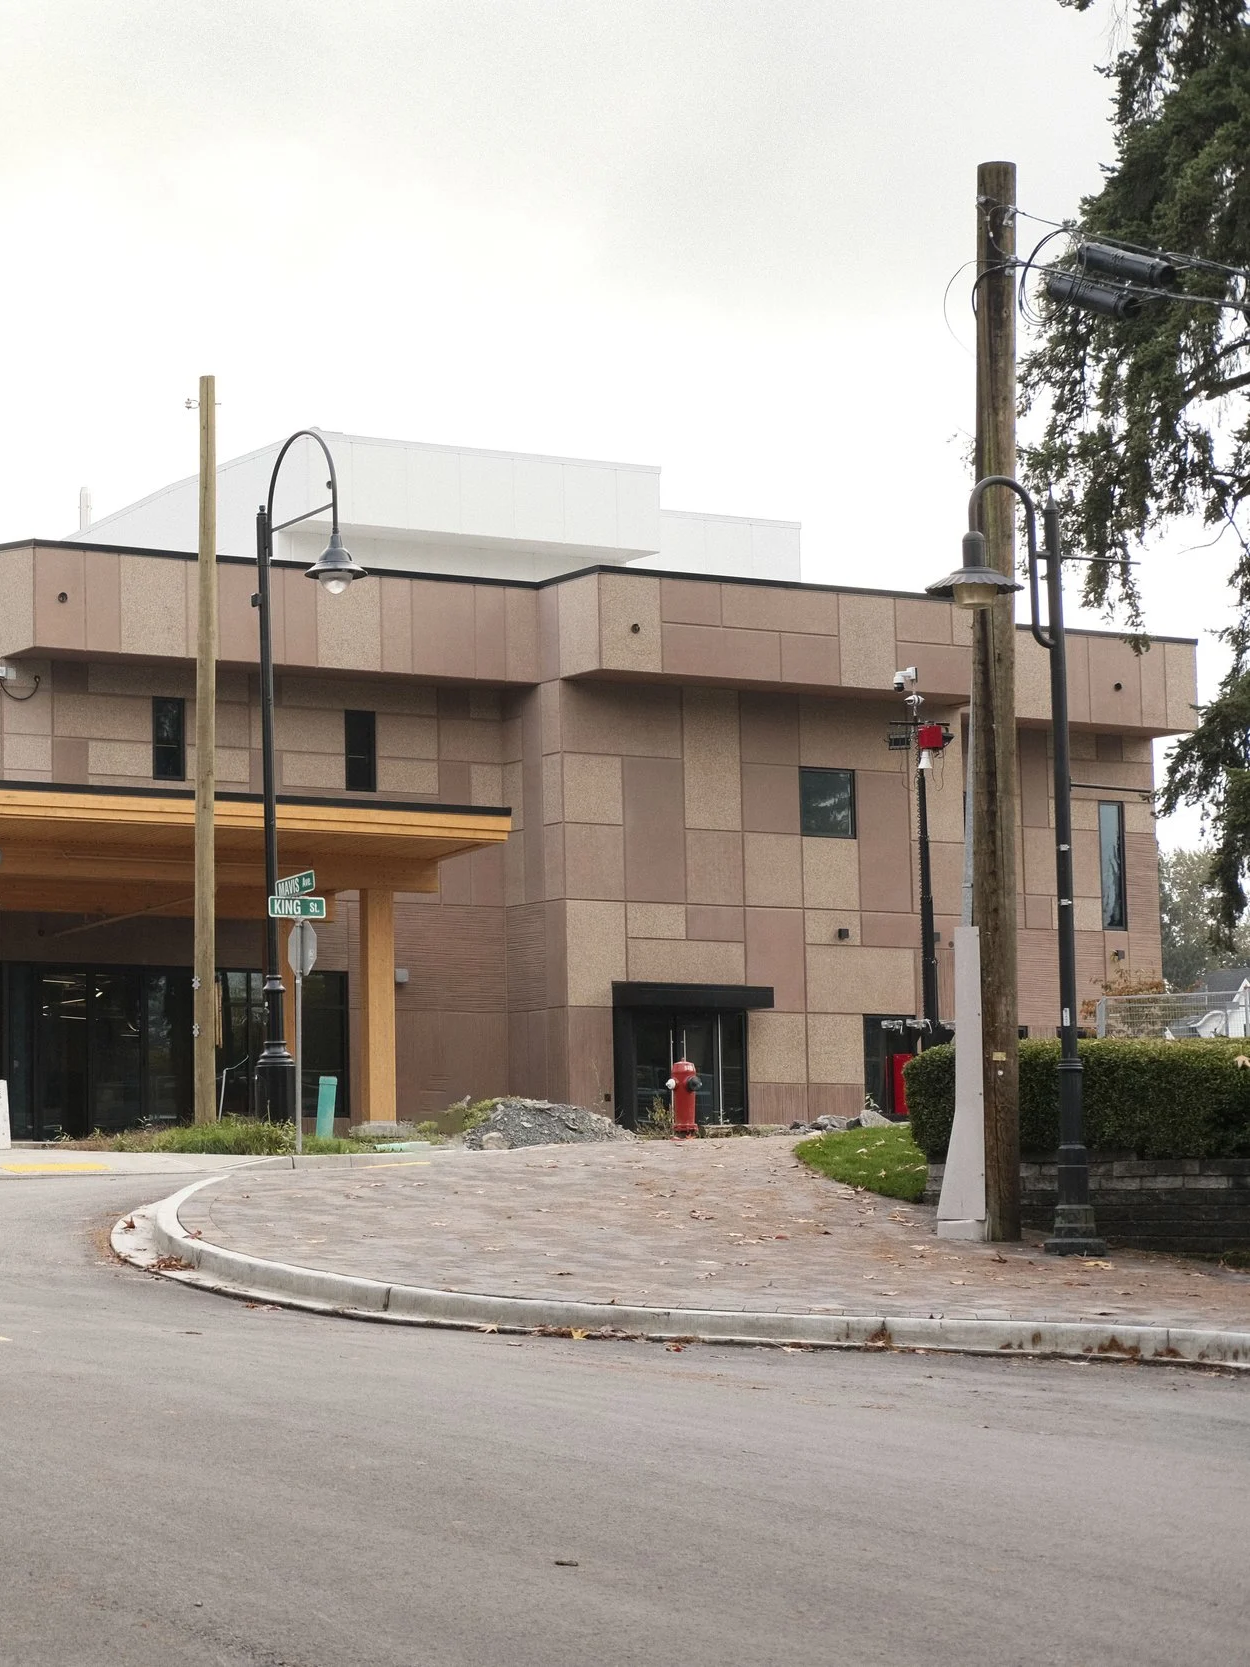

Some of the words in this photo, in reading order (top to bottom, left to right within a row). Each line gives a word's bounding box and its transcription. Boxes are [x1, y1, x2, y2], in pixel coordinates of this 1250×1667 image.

[278, 877, 300, 897] MAVIS
[274, 899, 302, 915] KING
[309, 901, 320, 913] St.
